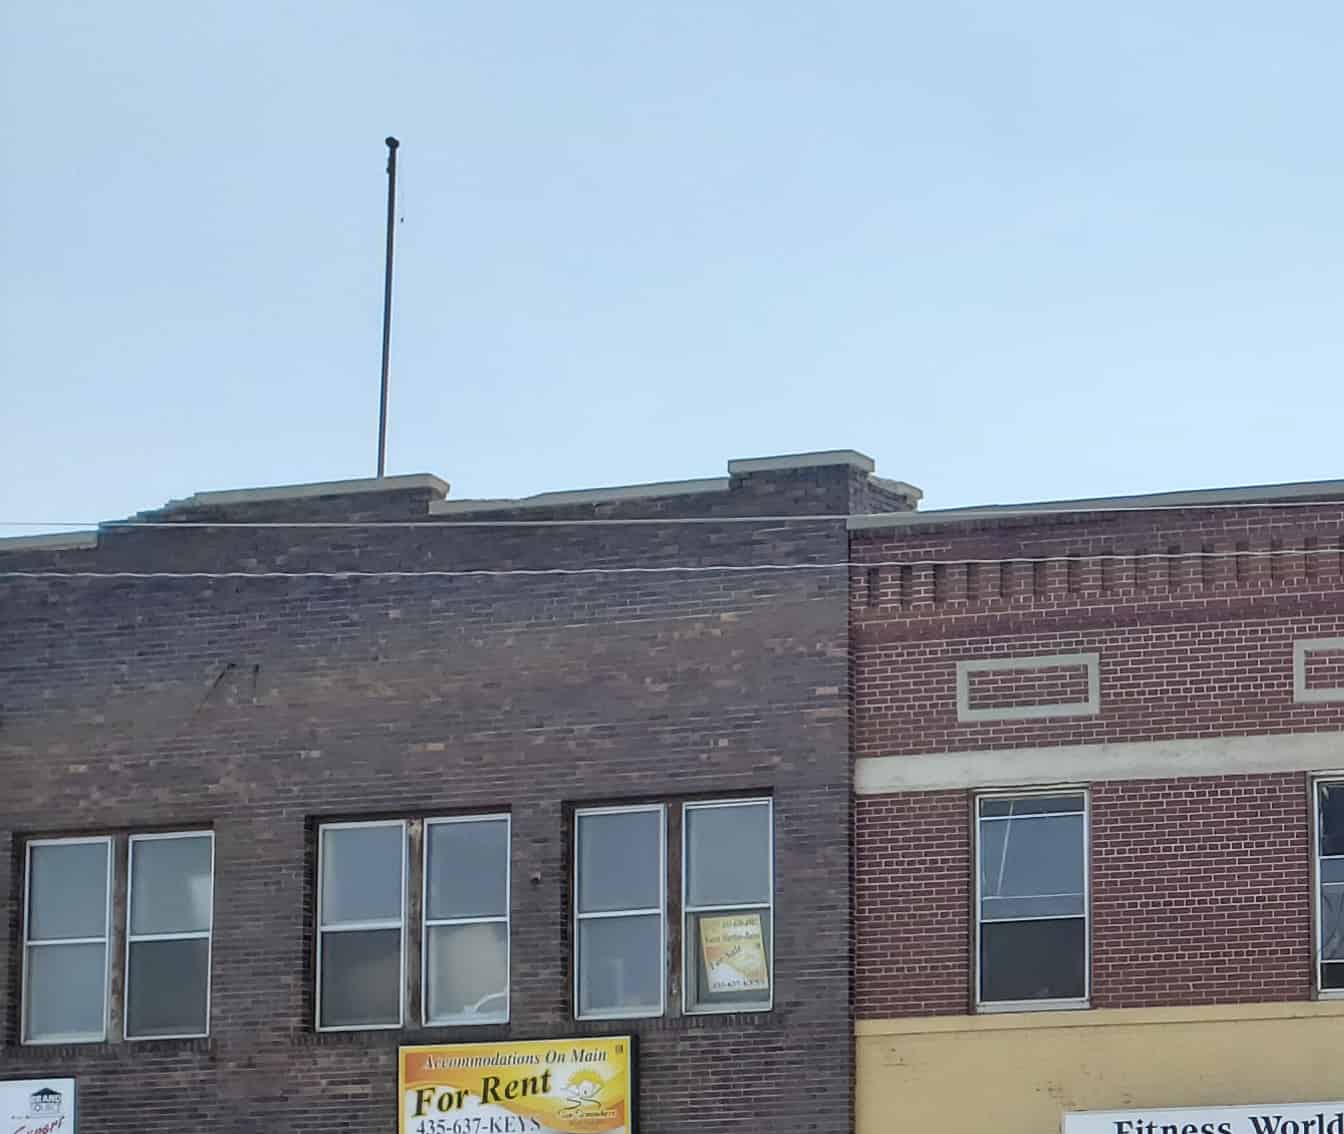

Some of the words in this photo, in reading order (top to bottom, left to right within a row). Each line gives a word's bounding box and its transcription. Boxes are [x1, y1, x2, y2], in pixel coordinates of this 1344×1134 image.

[423, 1051, 540, 1071] Accommodations
[545, 1050, 565, 1064] On
[570, 1049, 607, 1063] Main
[411, 1086, 469, 1118] For
[480, 1068, 552, 1105] Rent
